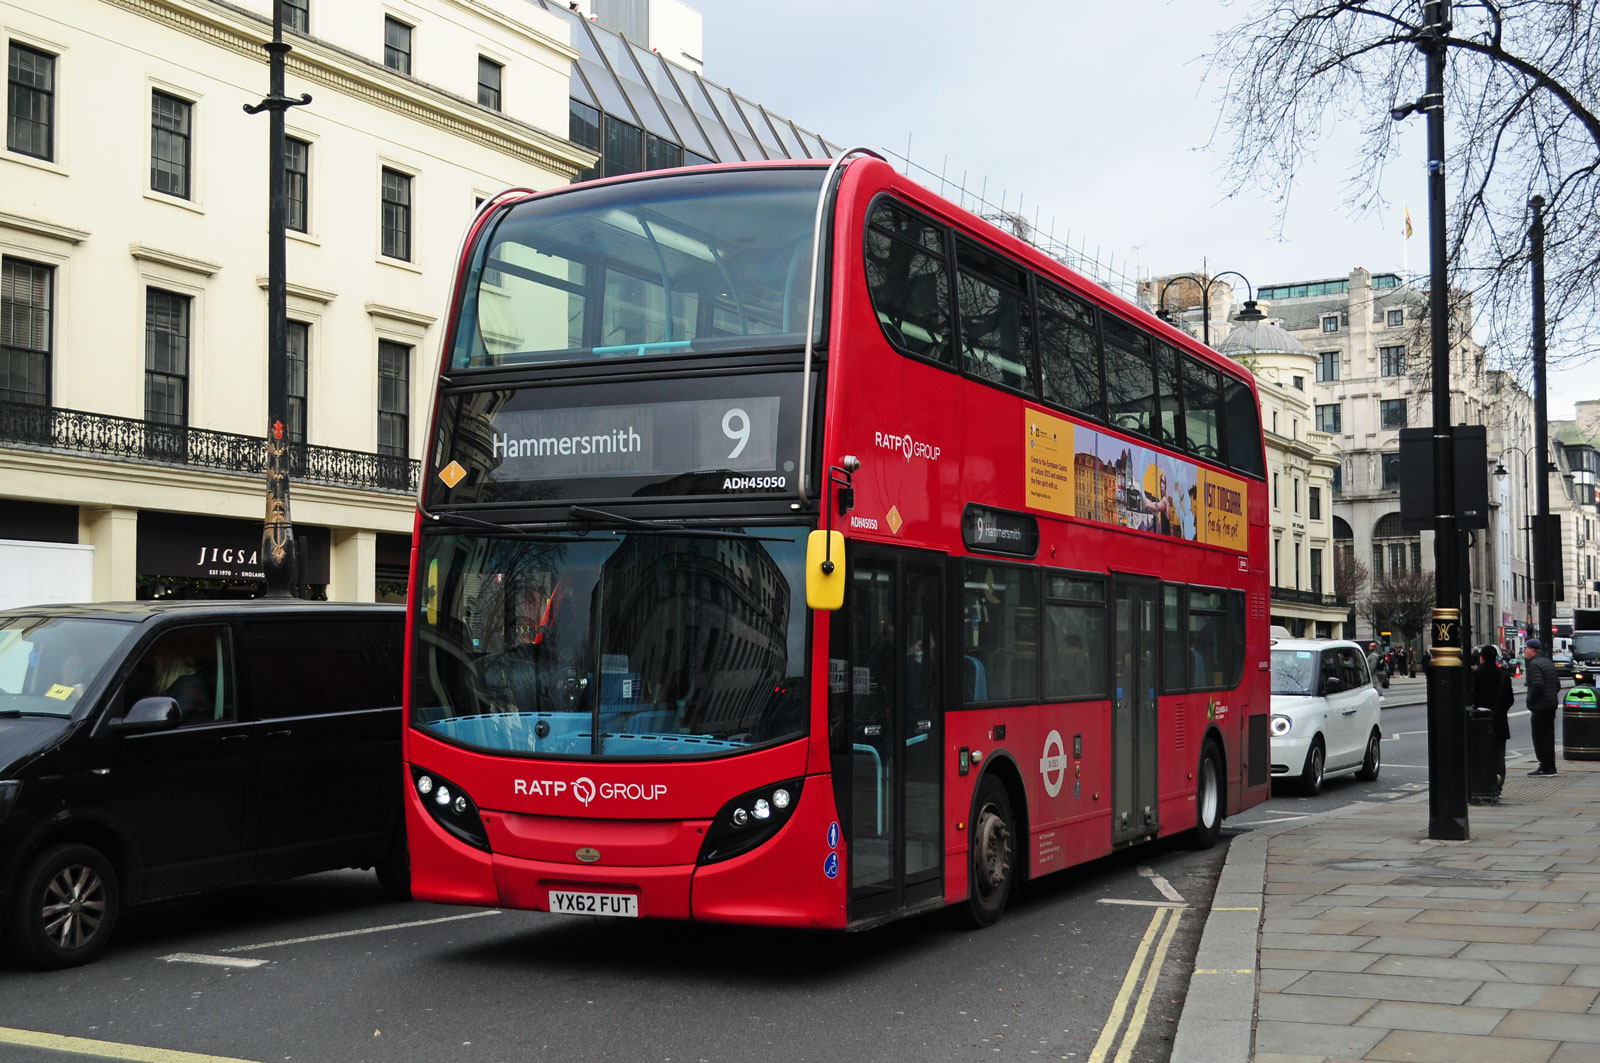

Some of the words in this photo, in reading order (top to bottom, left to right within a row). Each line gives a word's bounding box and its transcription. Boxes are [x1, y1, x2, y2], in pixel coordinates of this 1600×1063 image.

[492, 426, 641, 458] Hammersmith
[721, 408, 750, 459] 9
[875, 431, 902, 451] RATP
[914, 441, 941, 461] GROUP
[723, 476, 786, 489] ADH45050
[850, 516, 878, 530] ADH45050
[977, 517, 984, 540] 9
[986, 527, 1021, 540] Hammersmith
[197, 547, 257, 565] JIGSA
[514, 779, 567, 797] RATP
[599, 782, 667, 800] GROUP
[555, 893, 596, 912] YX62
[600, 896, 631, 914] FUT
